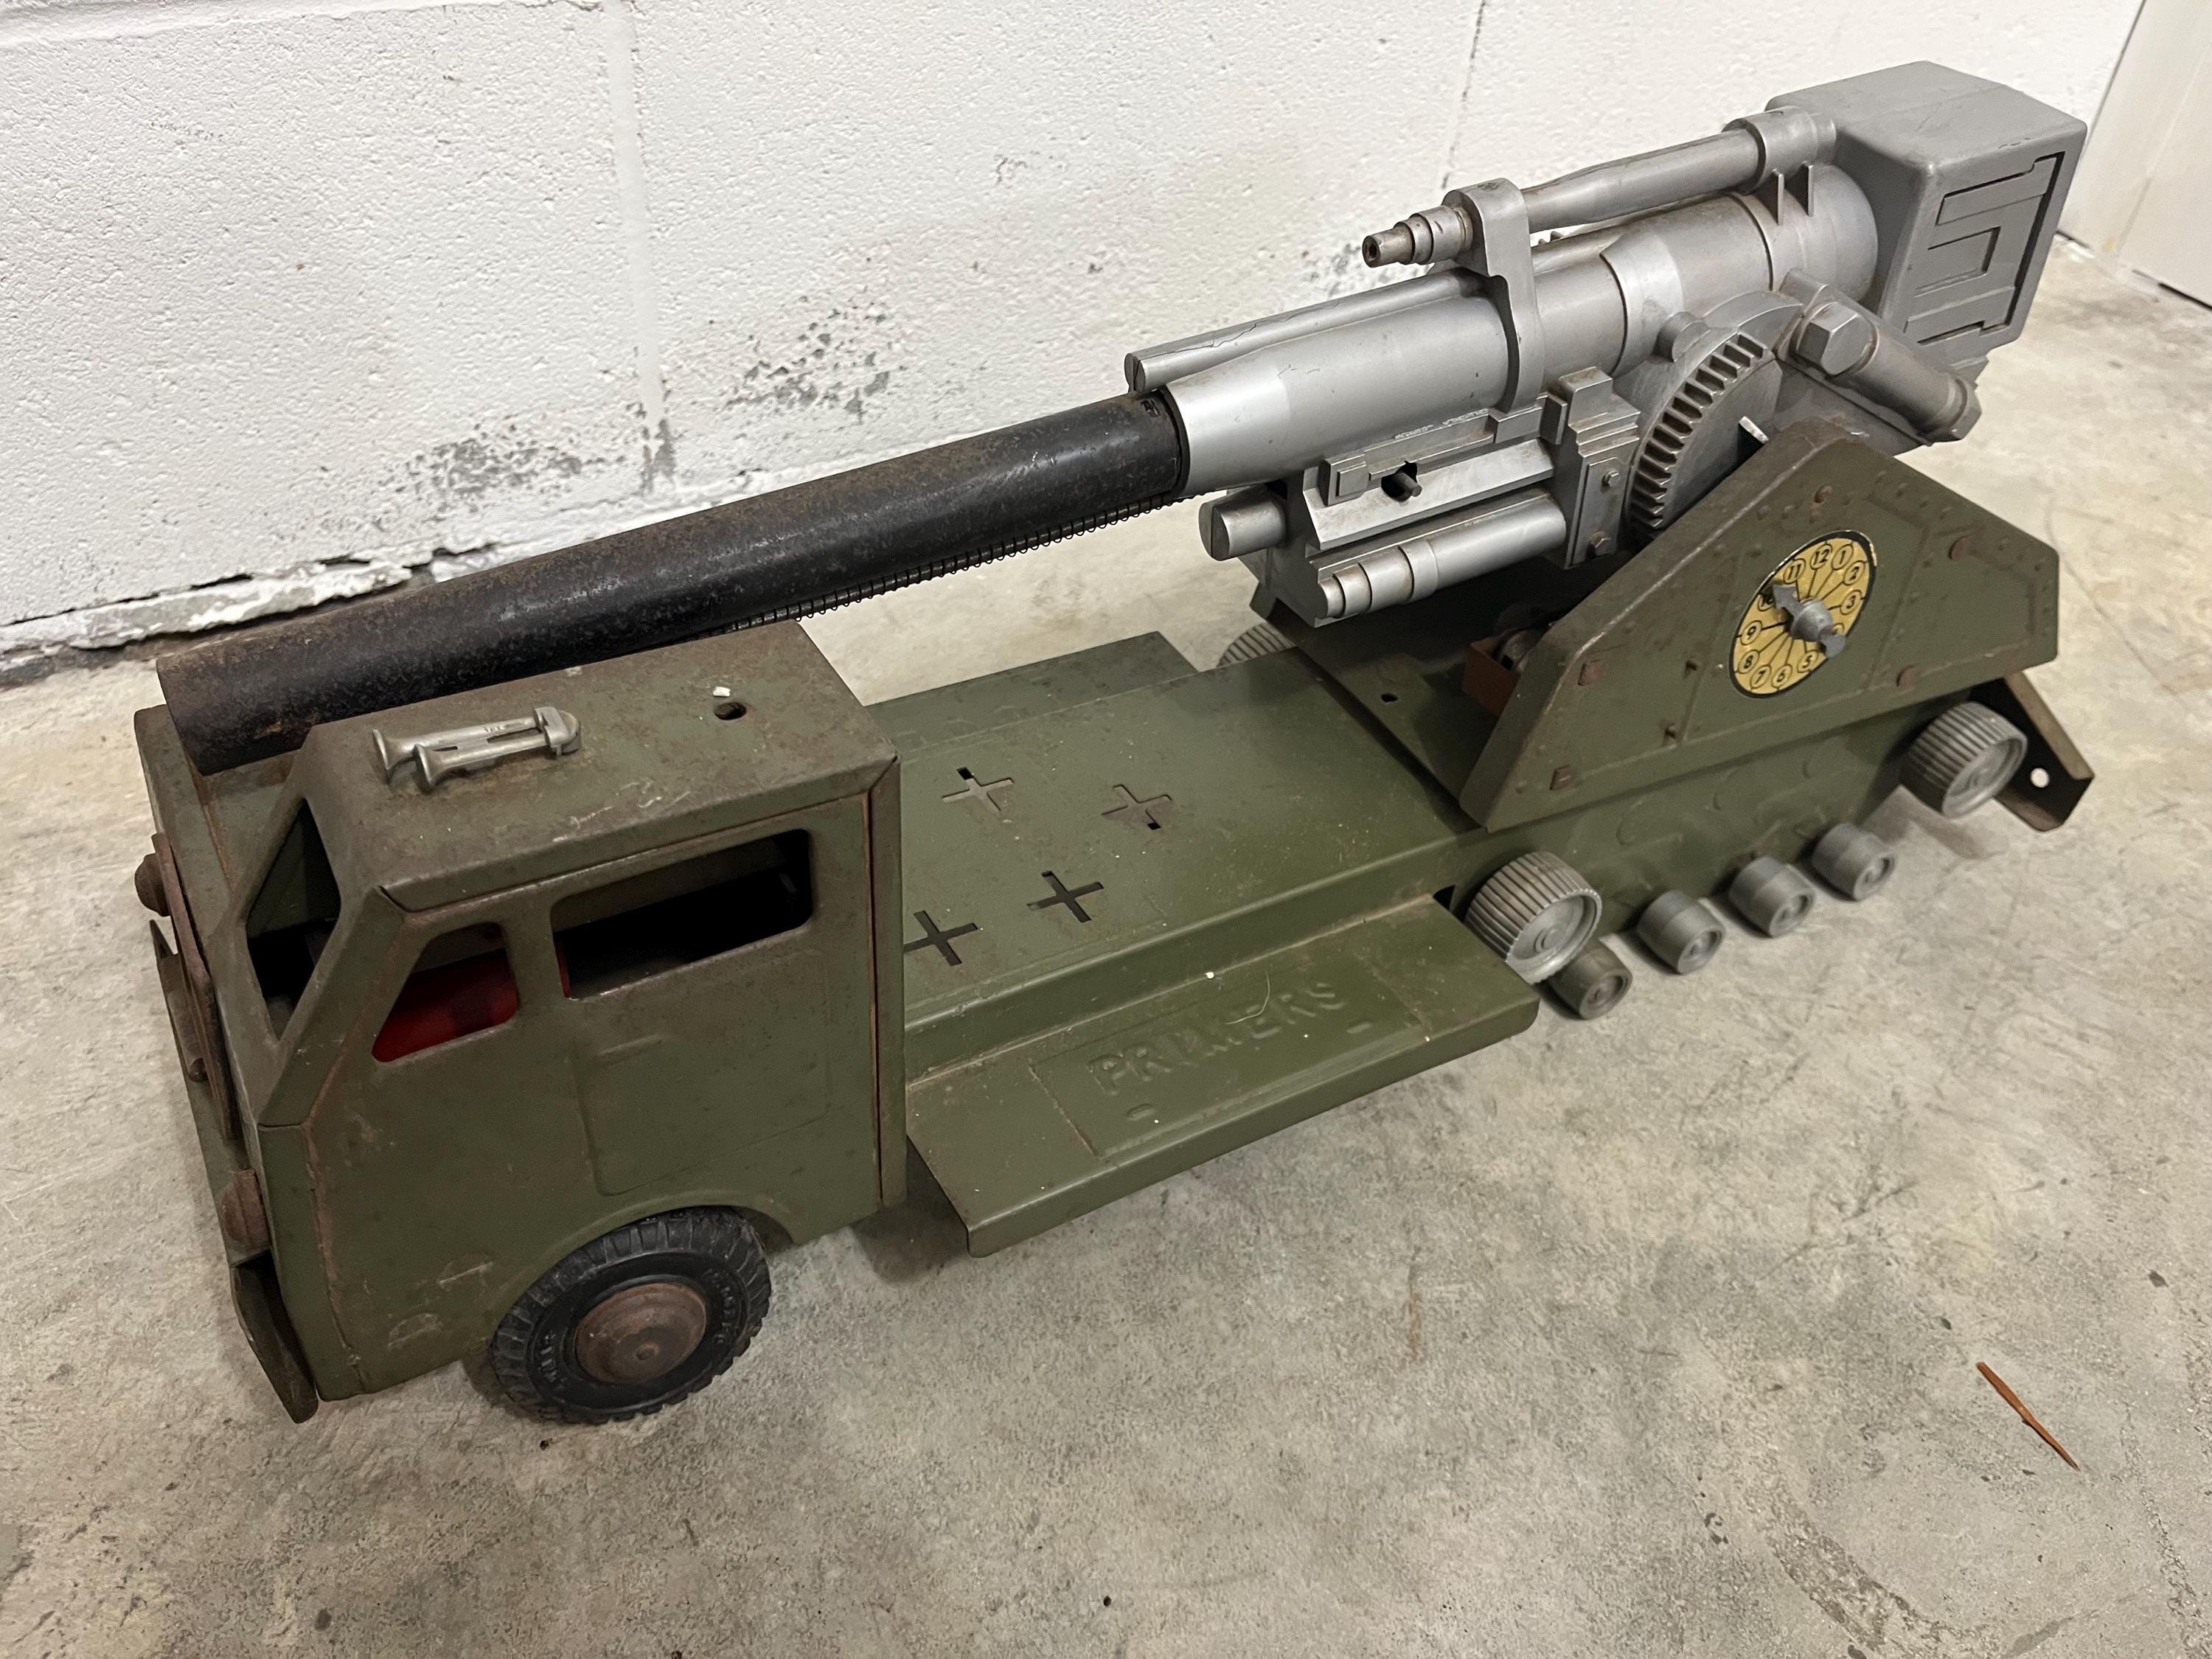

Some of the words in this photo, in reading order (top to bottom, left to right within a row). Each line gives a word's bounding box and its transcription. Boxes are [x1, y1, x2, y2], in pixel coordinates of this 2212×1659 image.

[1813, 549, 1829, 566] 12
[1839, 550, 1846, 565] 1
[1787, 563, 1802, 580] 11
[1848, 566, 1860, 580] 2
[1846, 595, 1857, 609] 3
[1747, 626, 1756, 640] 9
[1743, 655, 1754, 669] 8
[1802, 655, 1812, 669] 5
[1754, 669, 1766, 684] 7
[1777, 669, 1786, 683] 6
